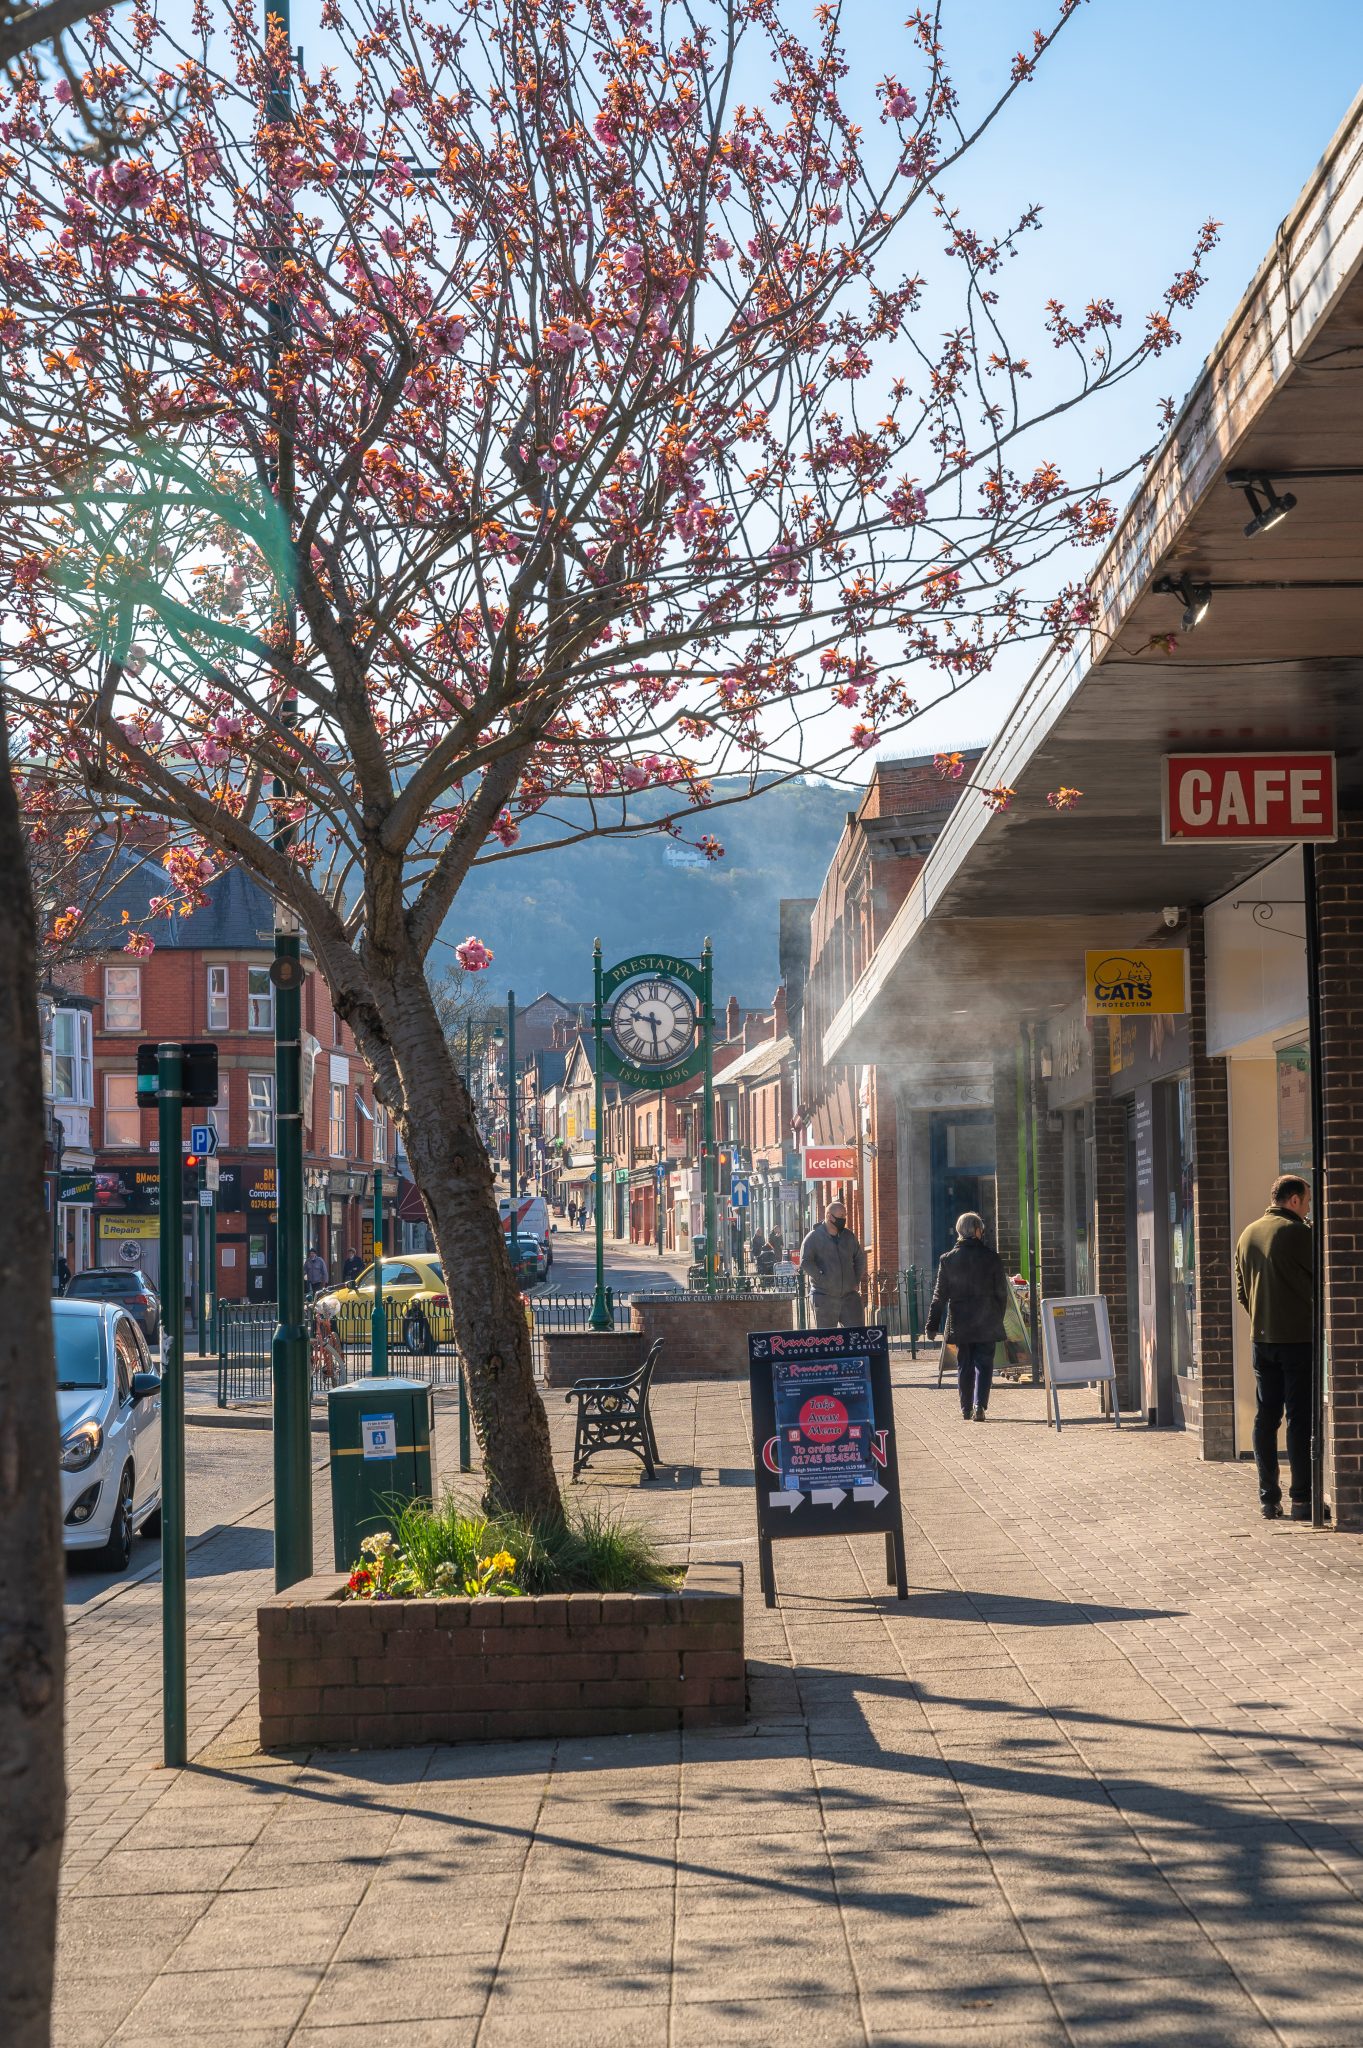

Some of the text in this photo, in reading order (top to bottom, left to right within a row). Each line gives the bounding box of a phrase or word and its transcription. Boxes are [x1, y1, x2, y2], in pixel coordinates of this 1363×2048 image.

[1179, 769, 1323, 826] CAFE
[612, 958, 694, 981] PRESTATYN
[1094, 982, 1153, 1001] CATS
[618, 1067, 648, 1086] 1896
[660, 1067, 689, 1086] 1996
[196, 1131, 206, 1151] P
[808, 1157, 854, 1169] Iceland
[136, 1172, 160, 1184] BM MOB
[264, 1168, 275, 1181] BM
[61, 1183, 90, 1199] SUBWAY
[142, 1185, 160, 1194] Lapt
[254, 1182, 275, 1190] MOBILE
[249, 1189, 277, 1199] Comput
[250, 1200, 267, 1208] 01745
[110, 1226, 141, 1235] Repairs
[770, 1334, 845, 1355] Rumours
[788, 1347, 819, 1355] COFFEE
[789, 1363, 838, 1378] Rumours
[809, 1399, 835, 1411] Take
[808, 1413, 839, 1423] Away
[808, 1426, 842, 1435] Menu
[792, 1441, 859, 1454] To order call:
[791, 1452, 862, 1466] 01745 854541
